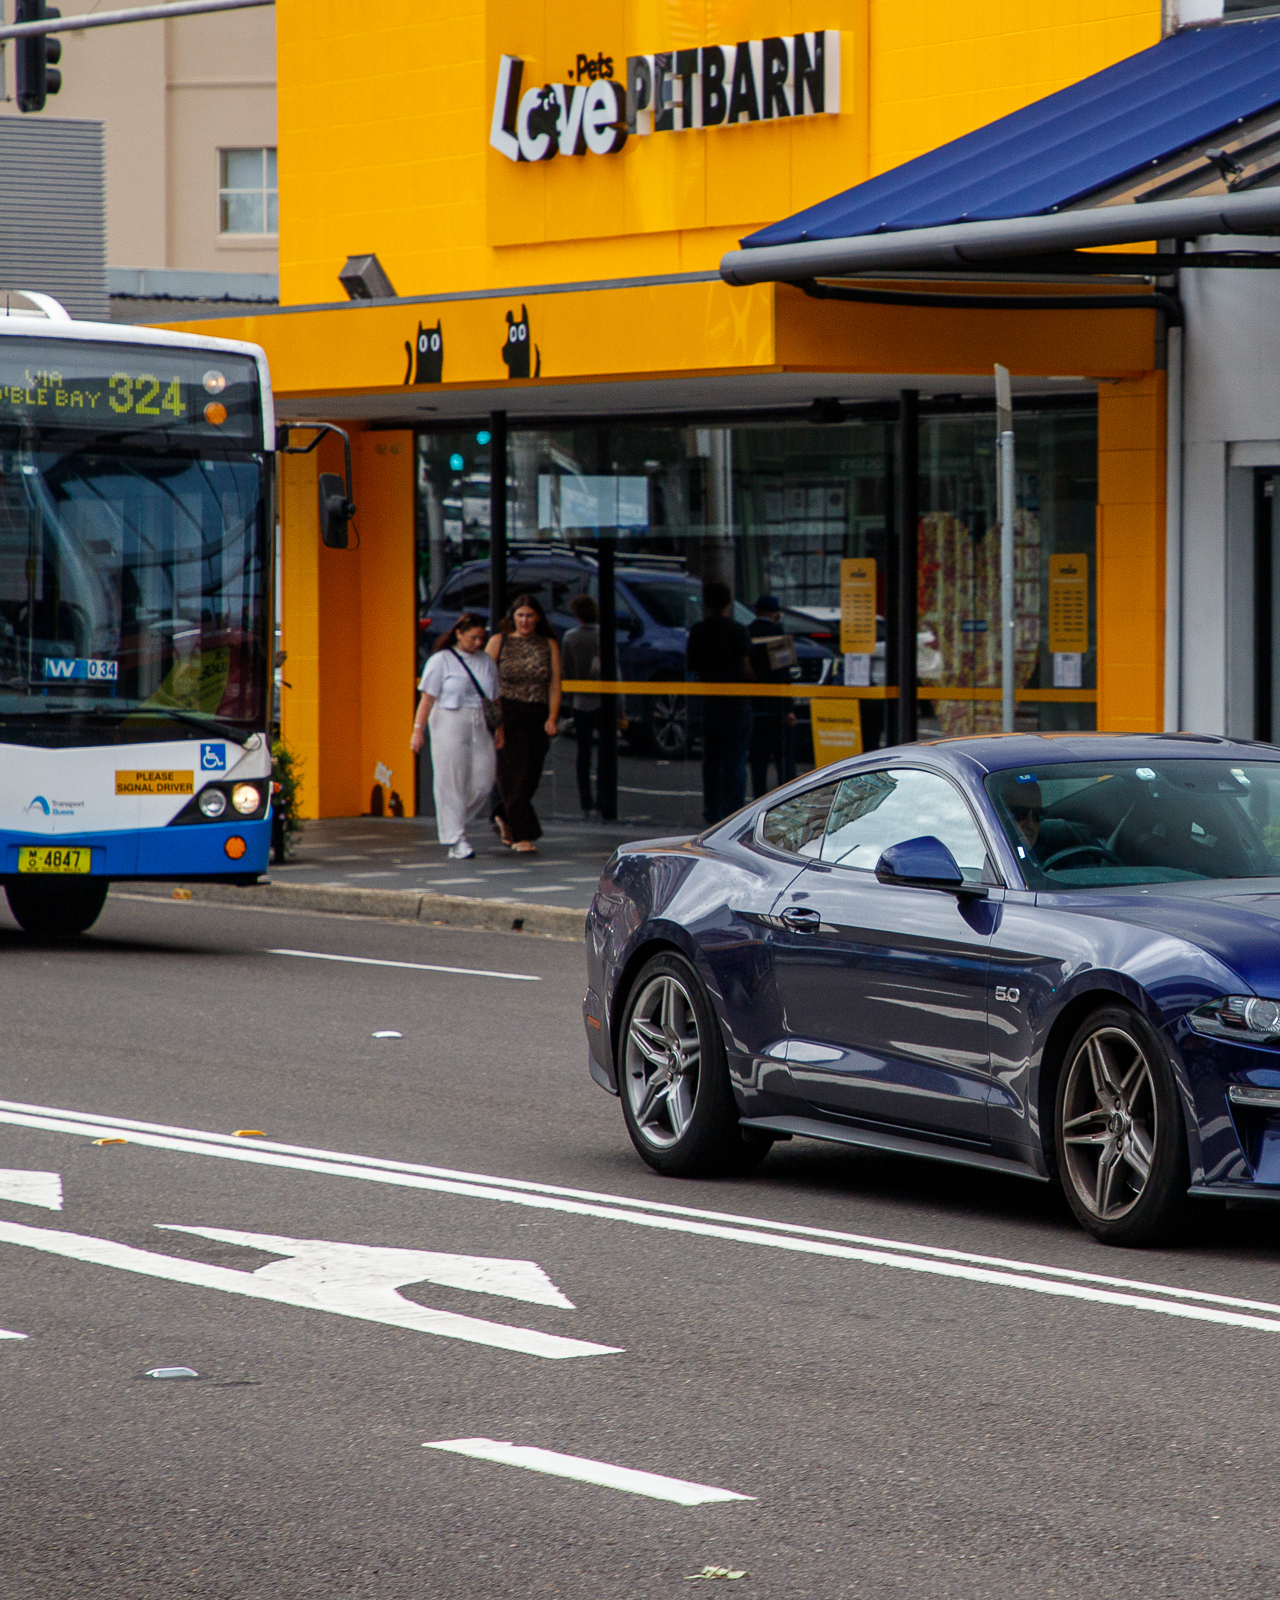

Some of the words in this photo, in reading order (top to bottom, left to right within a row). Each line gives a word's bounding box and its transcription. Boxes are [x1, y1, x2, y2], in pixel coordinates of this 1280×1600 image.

[576, 52, 614, 82] Pets
[489, 54, 626, 162] Love
[626, 29, 840, 135] PETBARN
[25, 368, 62, 387] VIA
[56, 389, 101, 408] BAY
[108, 371, 186, 416] 324
[48, 660, 76, 678] W
[136, 772, 174, 782] PLEASE
[117, 783, 154, 793] SIGNAL
[156, 782, 194, 793] DRIVER
[52, 799, 85, 809] Transport
[52, 808, 75, 816] Buses
[43, 850, 81, 868] 4847
[995, 986, 1020, 1003] 5.0
